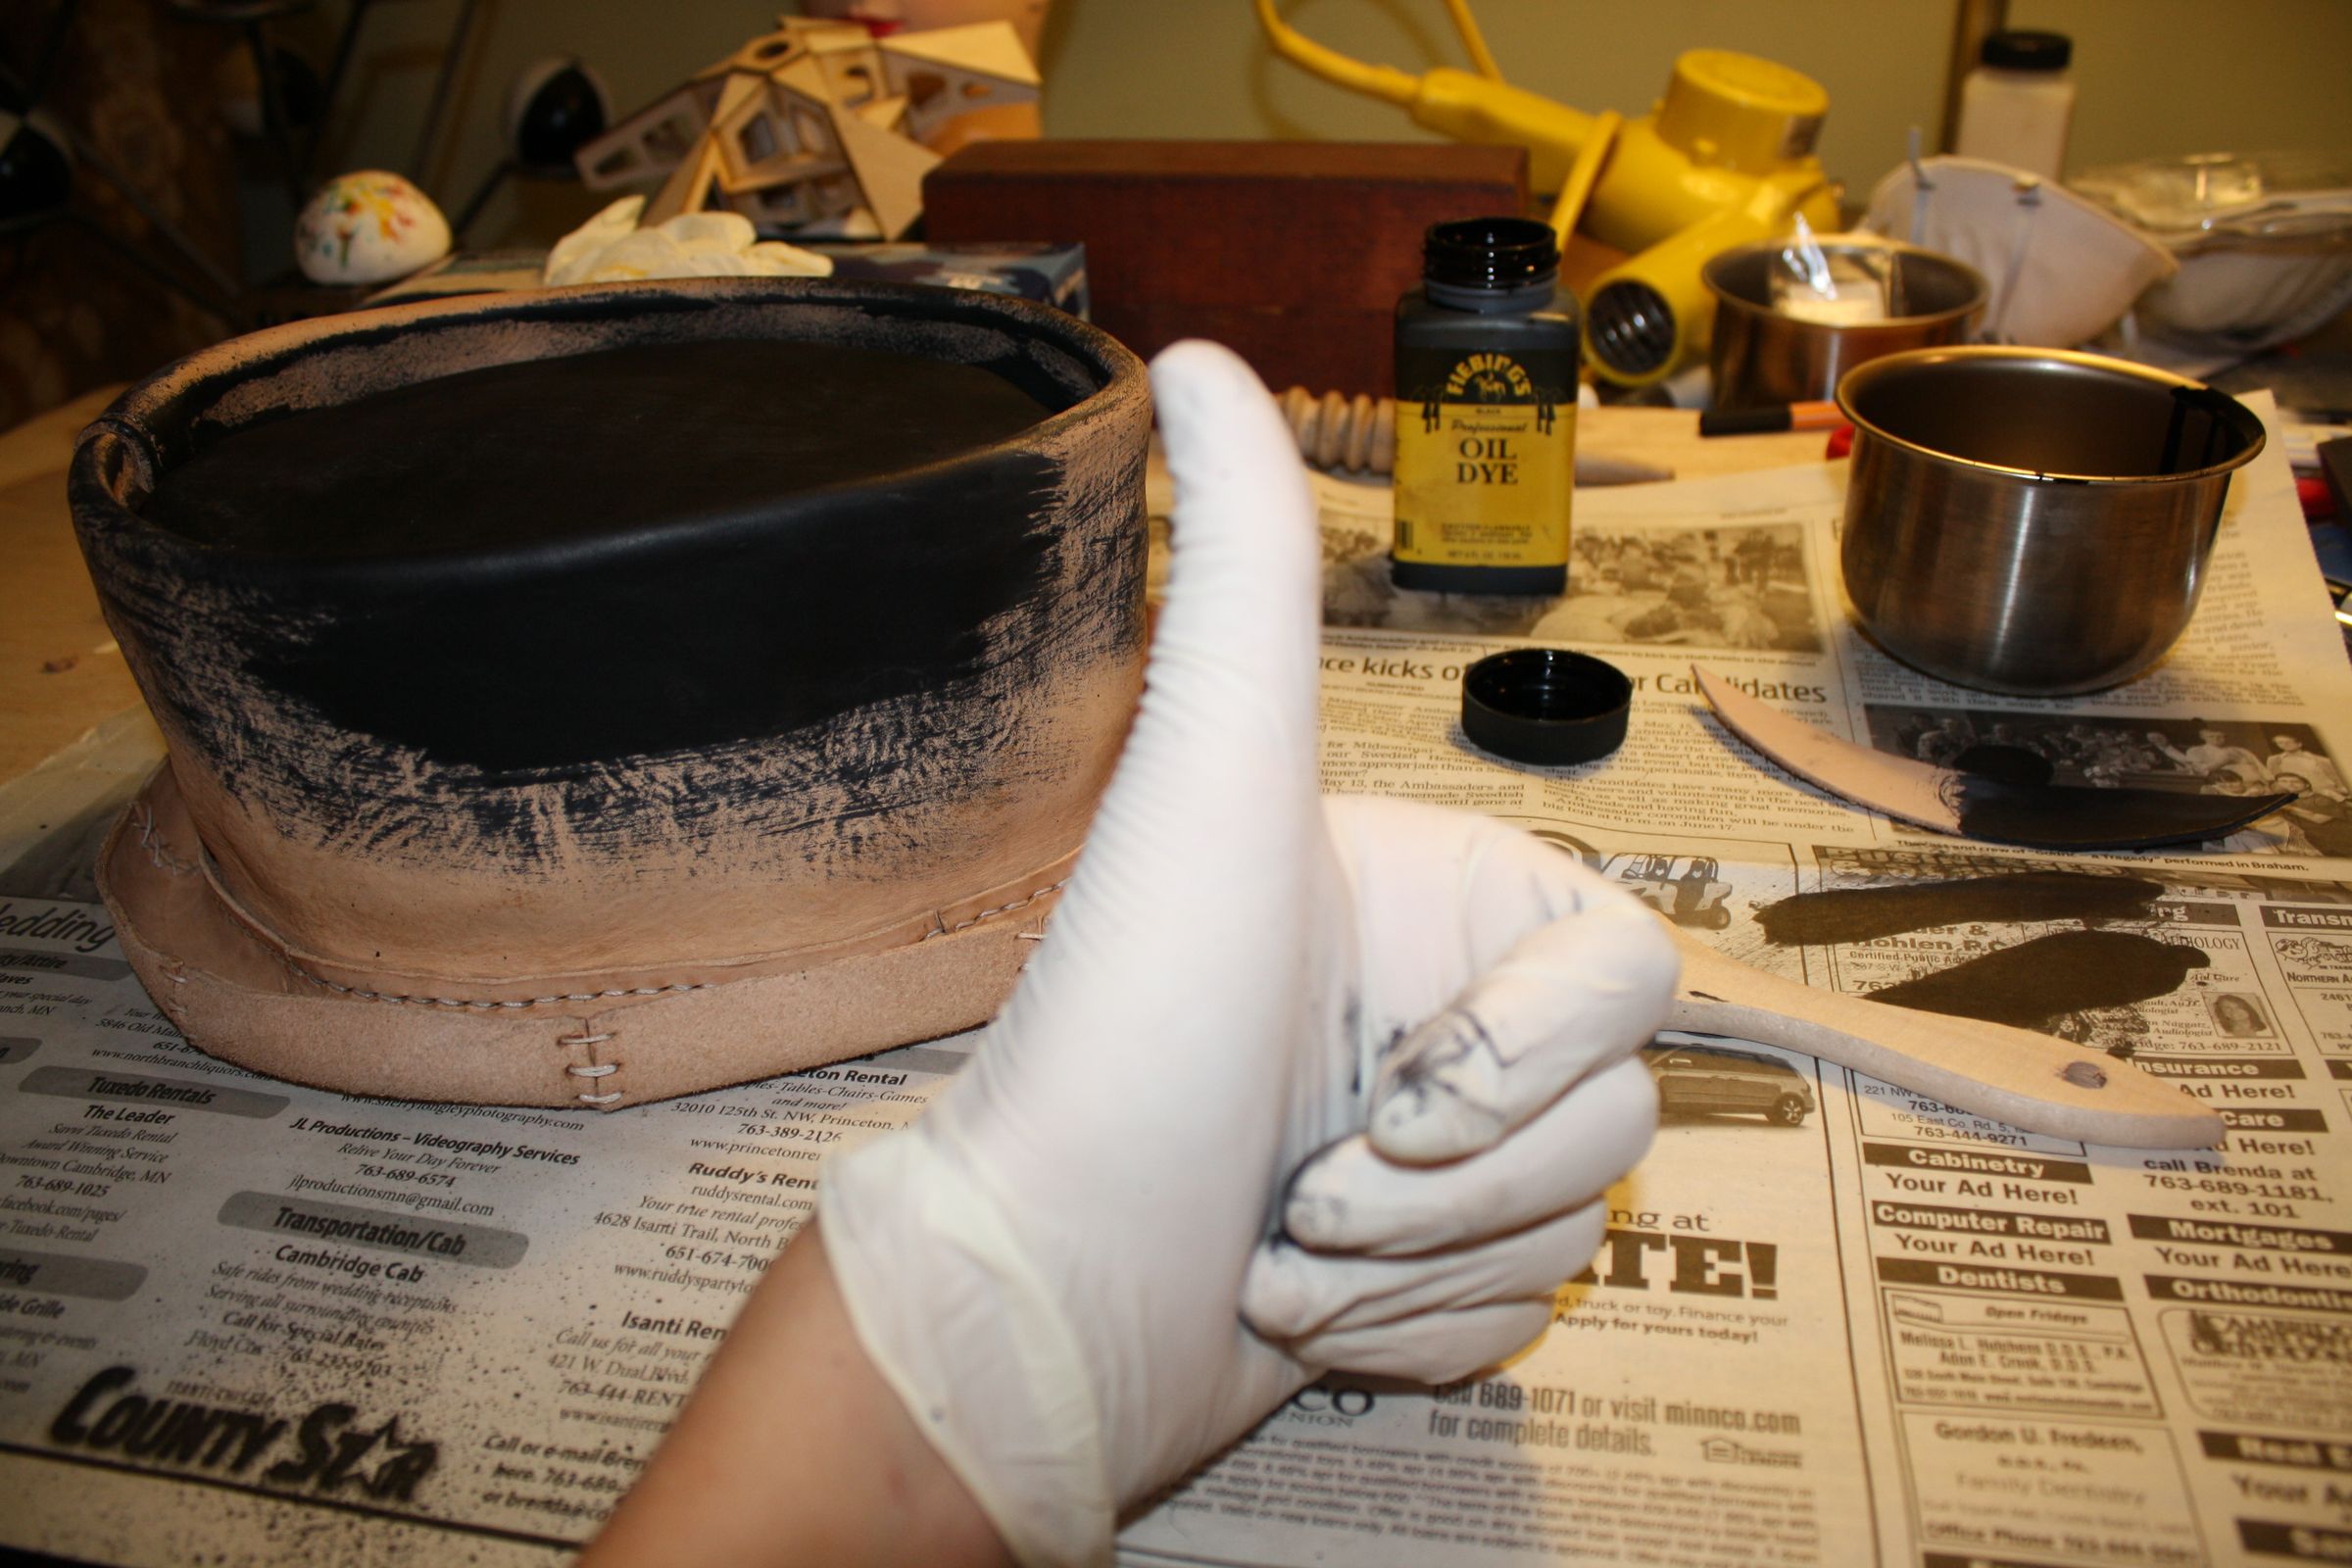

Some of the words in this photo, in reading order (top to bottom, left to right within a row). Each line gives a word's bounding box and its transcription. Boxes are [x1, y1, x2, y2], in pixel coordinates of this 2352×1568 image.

[1459, 437, 1518, 460] OIL
[1456, 462, 1519, 485] DYE
[1362, 657, 1434, 679] kicks
[2163, 856, 2234, 869] performed
[2251, 861, 2310, 872] Braham.
[127, 1022, 154, 1034] Old
[2179, 1041, 2281, 1053] 763-689-2121
[87, 1076, 148, 1099] Tuxedo
[145, 1082, 218, 1105] Rentals
[844, 1069, 908, 1087] Rental
[771, 1097, 808, 1110] and
[809, 1101, 848, 1112] more!
[2221, 1084, 2296, 1100] Here!
[82, 1104, 115, 1121] The
[114, 1107, 176, 1127] Leader
[670, 1102, 713, 1115] 32010
[716, 1104, 759, 1119] 125th
[760, 1108, 779, 1120] St.
[783, 1110, 816, 1125] NW,
[2221, 1110, 2285, 1128] Care
[288, 1117, 308, 1132] JL
[309, 1119, 403, 1144] Productions
[414, 1133, 514, 1159] Videography
[513, 1145, 581, 1166] Services
[736, 1123, 844, 1145] 763-389-2126
[1913, 1125, 2029, 1147] 763-444-9271
[2238, 1138, 2317, 1155] Here!
[381, 1148, 416, 1163] Your
[416, 1152, 447, 1170] Day
[448, 1157, 503, 1175] Forever
[688, 1162, 768, 1186] Ruddy's
[1908, 1149, 2046, 1179] Cabinetry
[2142, 1158, 2186, 1172] call
[2194, 1160, 2282, 1181] Brenda
[2291, 1167, 2319, 1182] at
[354, 1163, 457, 1189] 763-689-6574
[1885, 1172, 1947, 1195] Your
[1956, 1178, 1993, 1199] Ad
[2002, 1182, 2080, 1205] Here!
[2142, 1174, 2335, 1204] 763-689-1181,
[637, 1195, 675, 1211] Your
[676, 1202, 710, 1218] true
[710, 1207, 757, 1227] rental
[690, 1185, 813, 1211] ruddysrental.com
[2189, 1199, 2240, 1215] ext.
[2246, 1201, 2302, 1220] 101
[273, 1206, 467, 1257] Transportation/Cab
[593, 1210, 632, 1228] 4628
[632, 1216, 678, 1236] Isanti
[680, 1223, 720, 1244] Trail,
[722, 1230, 773, 1250] North
[1671, 1212, 1711, 1233] at
[1876, 1203, 2009, 1234] Computer
[2015, 1216, 2106, 1242] Repair
[2166, 1220, 2336, 1252] Mortgages
[1894, 1233, 1959, 1255] Your
[1969, 1239, 2008, 1260] Ad
[2016, 1243, 2097, 1267] Here!
[2154, 1246, 2222, 1269] Your
[2232, 1252, 2272, 1274] Ad
[2279, 1257, 2352, 1280] Here
[274, 1244, 382, 1280] Cambridge
[384, 1261, 426, 1285] Cab
[1936, 1264, 2068, 1295] Dentists
[619, 1310, 685, 1336] Isanti
[1554, 1311, 1609, 1331] Apply
[1642, 1322, 1694, 1339] yours
[1696, 1327, 1759, 1346] today!
[1478, 1381, 1576, 1415] 689-1071
[1581, 1396, 1602, 1419] or
[1609, 1396, 1658, 1424] visit
[1664, 1399, 1802, 1437] minnco.com
[1428, 1408, 1459, 1438] for
[1465, 1417, 1570, 1450] complete
[1575, 1421, 1658, 1457] details.
